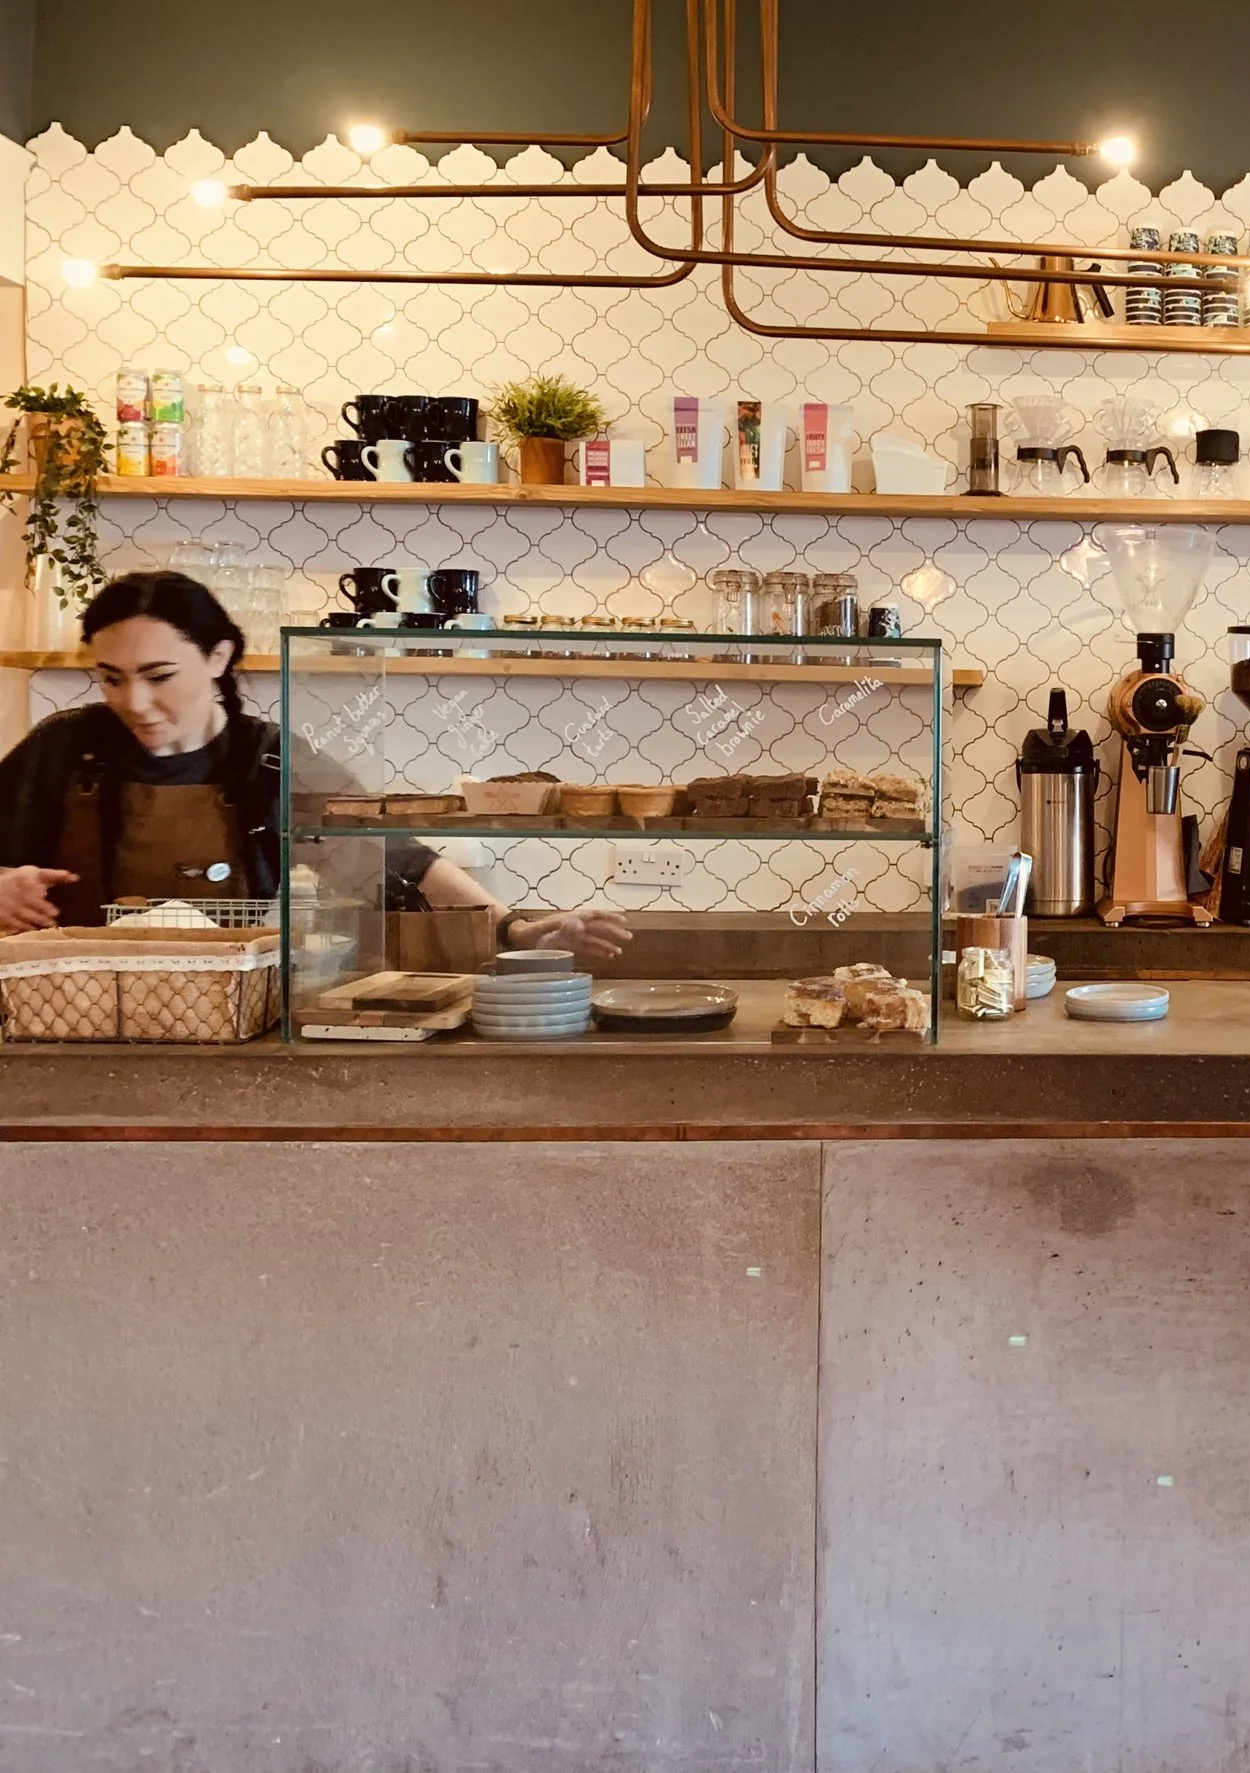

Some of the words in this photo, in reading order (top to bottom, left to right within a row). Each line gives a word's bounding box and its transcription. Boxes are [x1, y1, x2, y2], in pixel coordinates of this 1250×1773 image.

[302, 715, 346, 754] Peanut
[342, 686, 380, 722] butter
[432, 690, 468, 721] Vegan
[564, 695, 614, 742] Custard
[686, 684, 728, 724] Salted
[582, 729, 614, 757] tarts
[715, 710, 765, 757] brownie
[790, 868, 861, 926] Cinnamon
[827, 899, 860, 928] rolls
